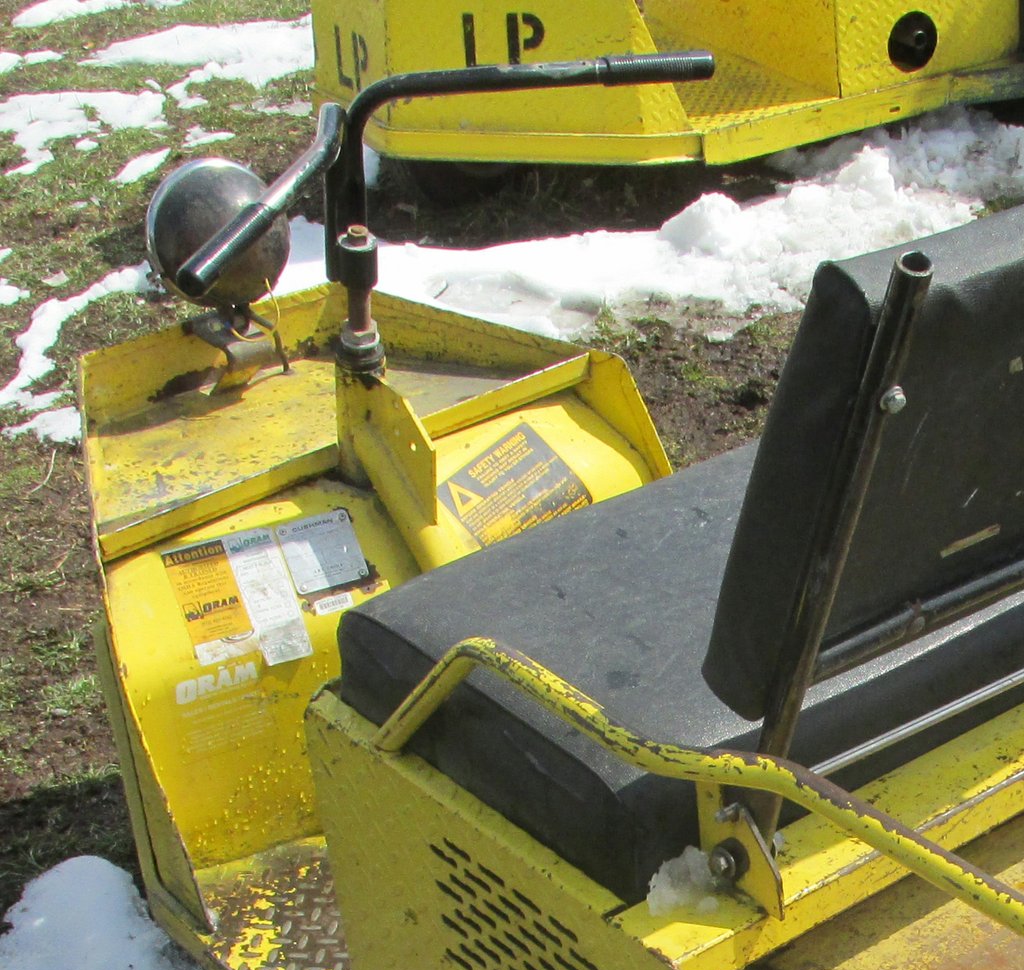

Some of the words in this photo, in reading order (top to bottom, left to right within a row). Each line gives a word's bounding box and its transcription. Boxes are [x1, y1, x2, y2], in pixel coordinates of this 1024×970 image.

[334, 24, 368, 93] LP
[461, 12, 545, 67] LP
[468, 453, 495, 478] SAFETY
[493, 431, 526, 459] WARNING
[165, 545, 224, 567] Attention
[202, 595, 239, 614] ORAM
[176, 661, 258, 705] ORAM
